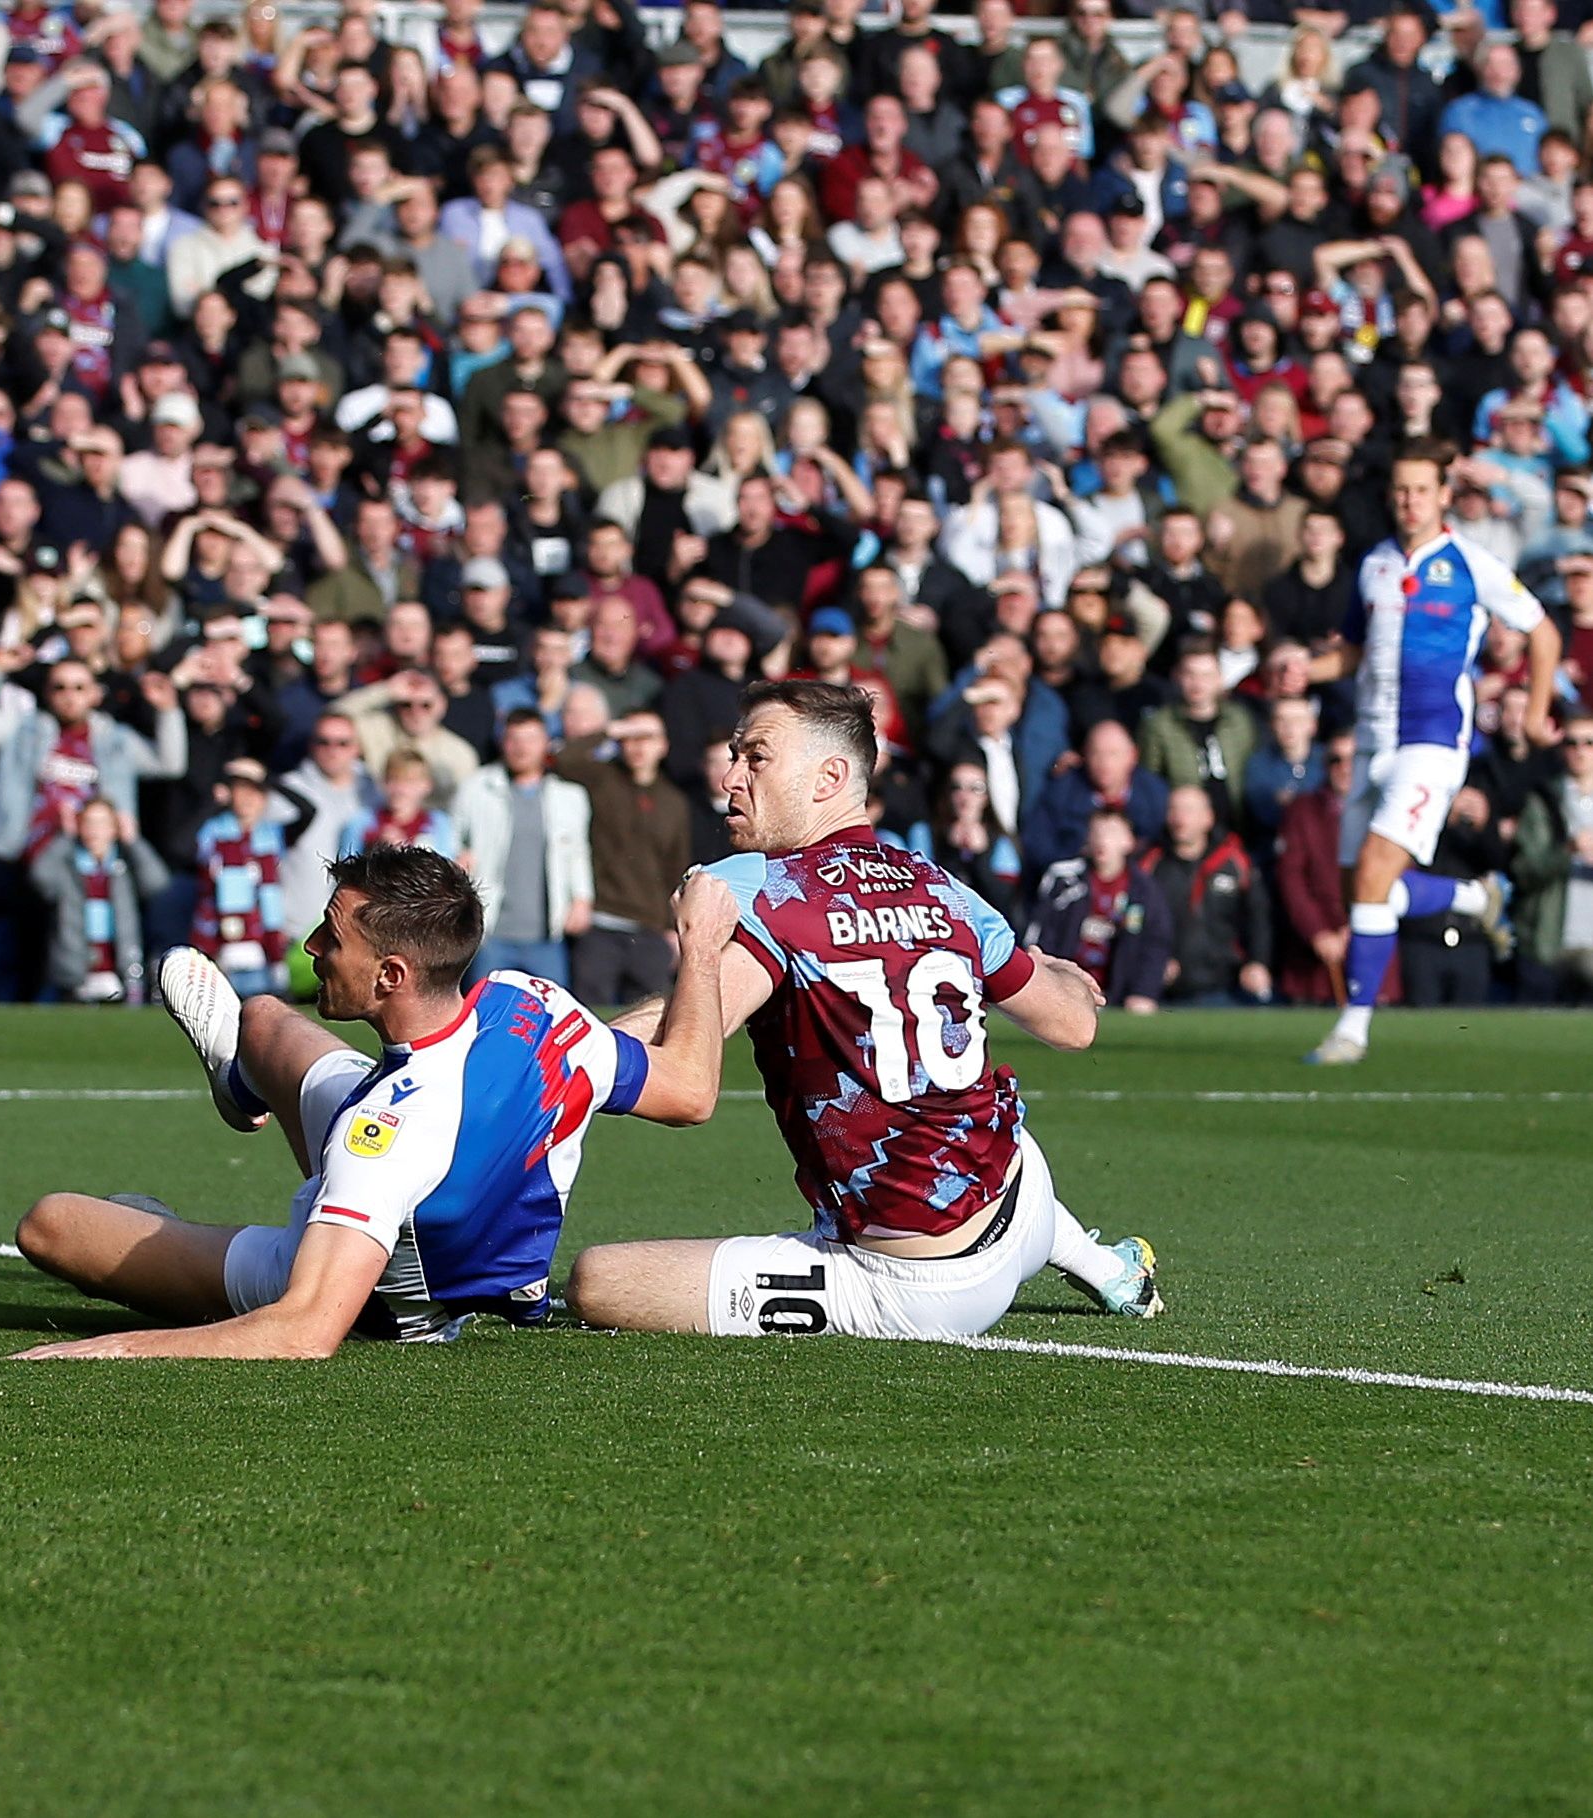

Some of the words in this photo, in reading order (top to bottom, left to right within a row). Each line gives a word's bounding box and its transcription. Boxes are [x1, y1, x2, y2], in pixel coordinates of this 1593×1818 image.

[841, 859, 915, 881] Vertu
[857, 881, 914, 895] Motors
[826, 904, 954, 946] BARNES
[825, 950, 987, 1103] 10
[756, 1264, 828, 1334] 10
